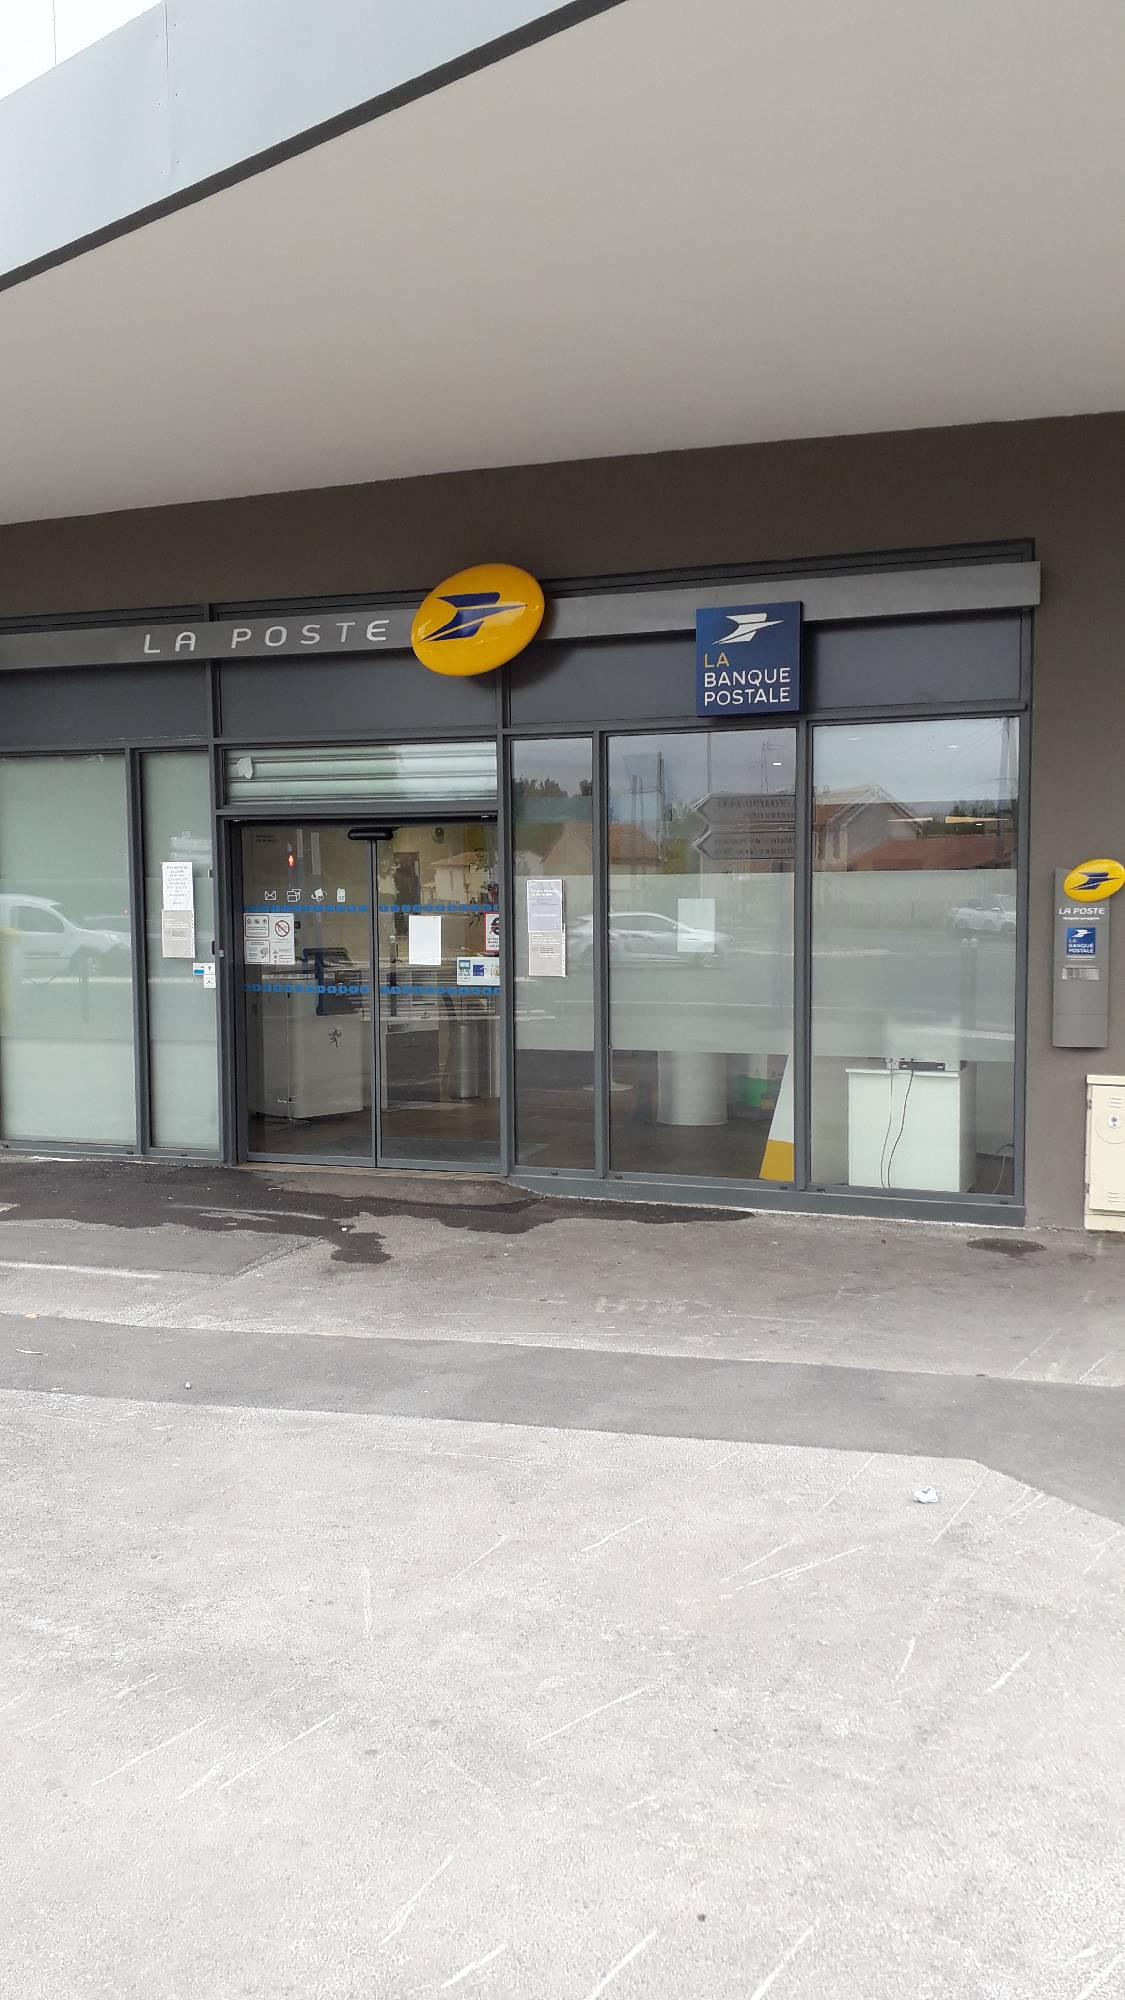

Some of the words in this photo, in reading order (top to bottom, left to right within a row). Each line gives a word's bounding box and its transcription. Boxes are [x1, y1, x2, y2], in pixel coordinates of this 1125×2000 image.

[143, 631, 196, 654] LA
[231, 619, 390, 649] POSTE
[704, 651, 730, 668] LA
[704, 667, 791, 688] BANQUE
[704, 687, 791, 707] POSTALE
[1058, 907, 1071, 915] LA
[1073, 907, 1106, 915] POSTE
